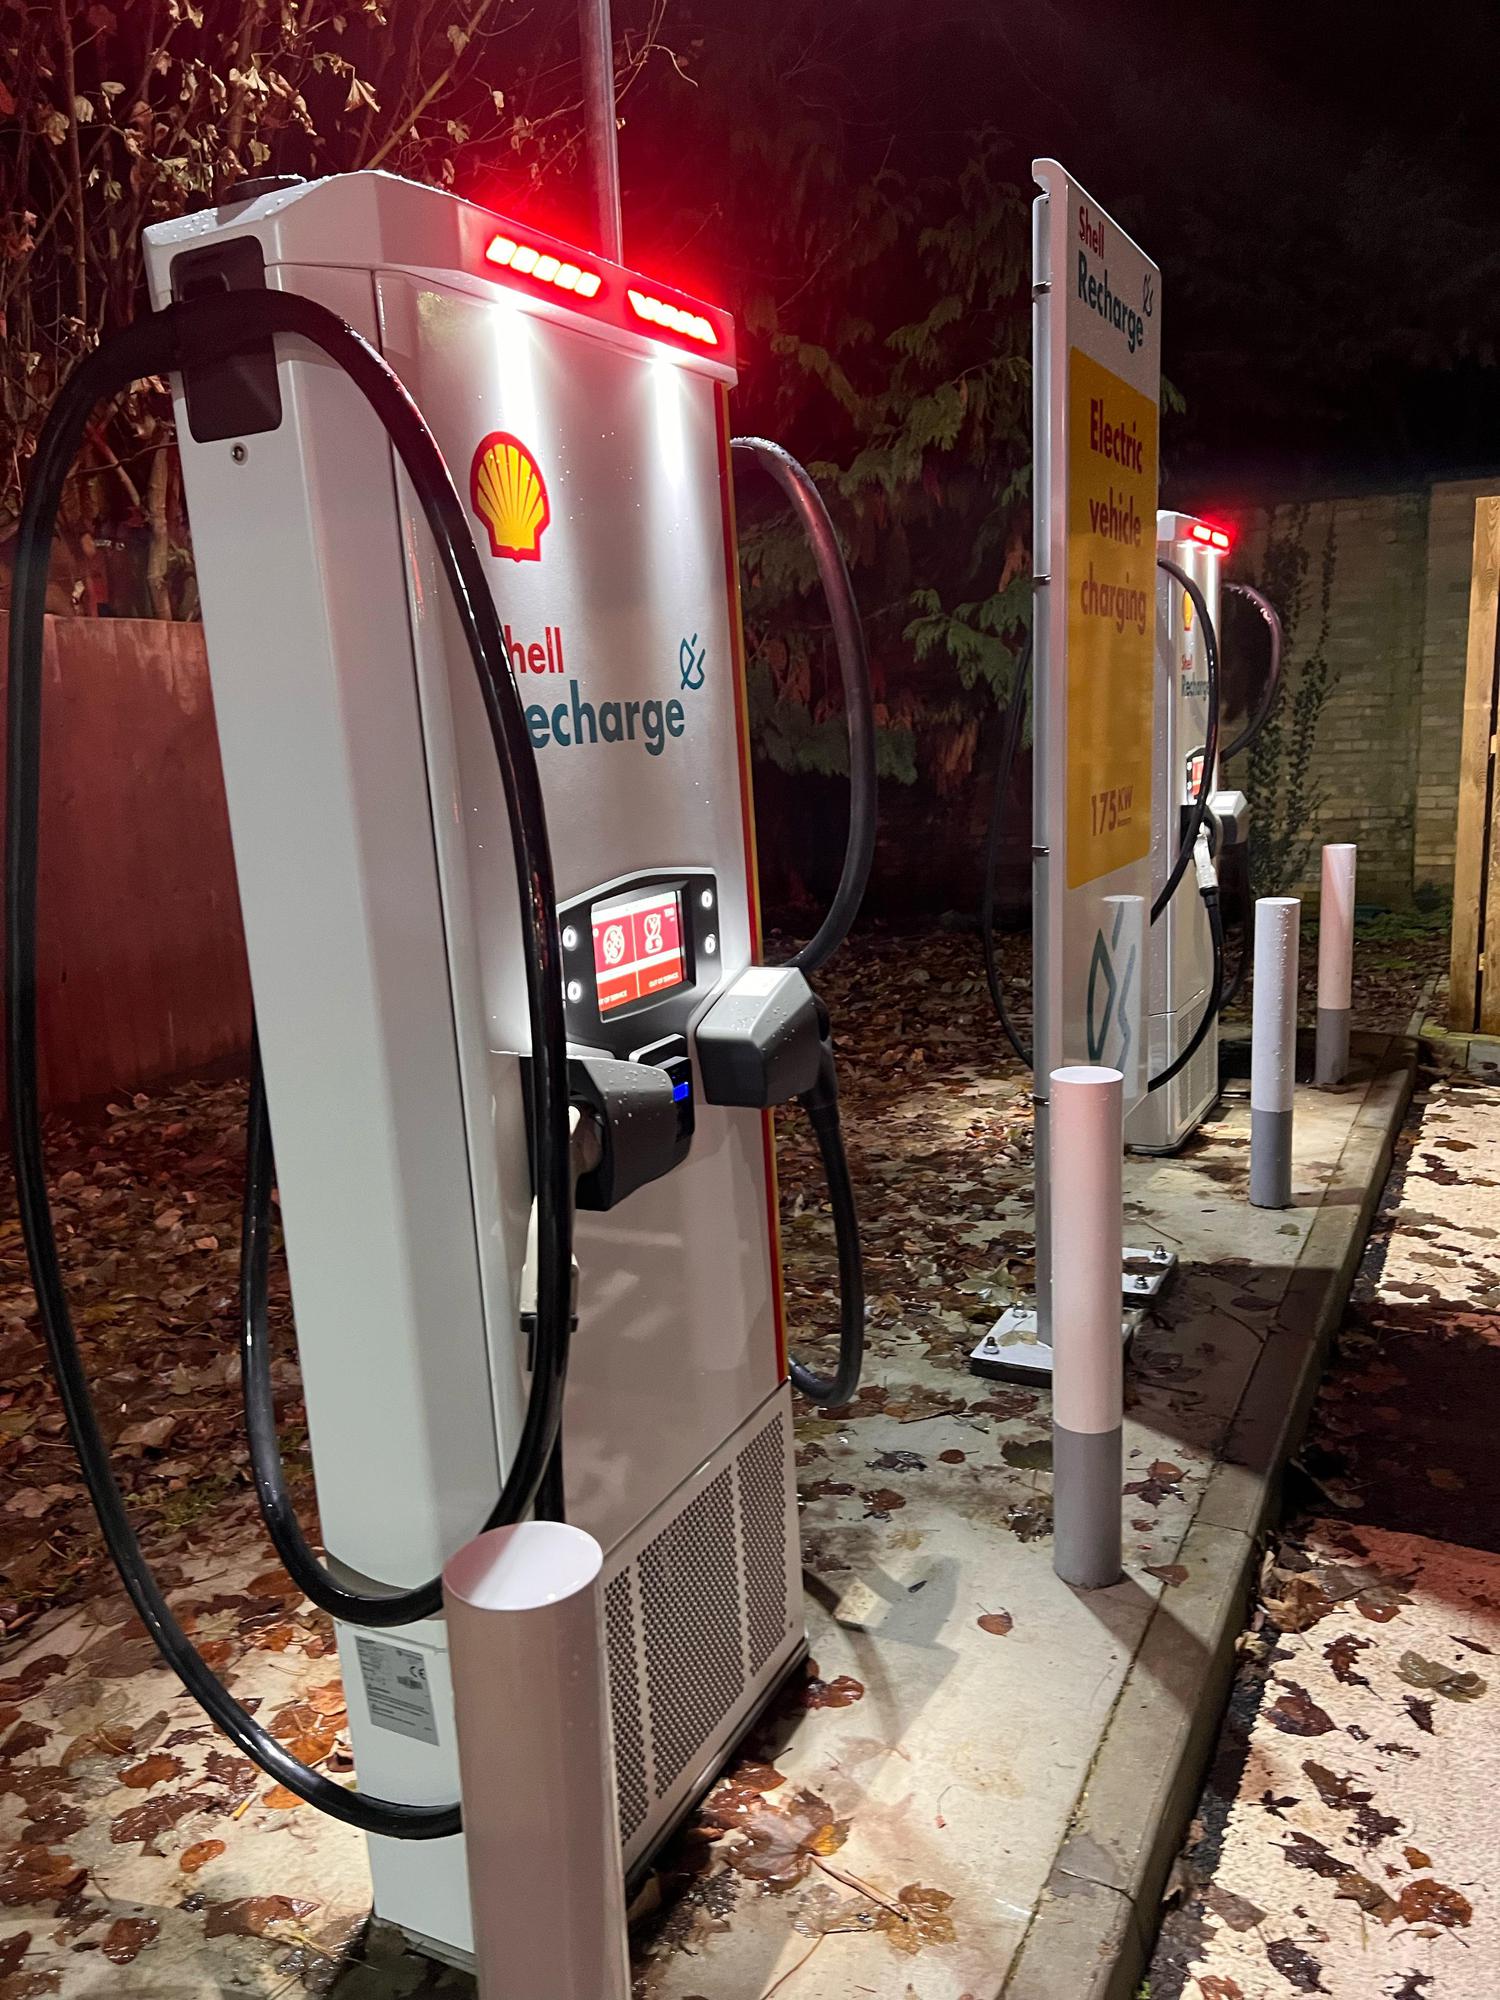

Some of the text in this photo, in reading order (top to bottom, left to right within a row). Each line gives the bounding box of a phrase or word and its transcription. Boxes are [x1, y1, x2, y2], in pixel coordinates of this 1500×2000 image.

[1079, 206, 1104, 260] Shell
[1078, 249, 1144, 354] Recharge
[1090, 398, 1143, 474] Electric
[1089, 487, 1142, 547] vehicle
[1081, 562, 1147, 635] charging
[504, 625, 564, 674] hell
[524, 679, 686, 757] echarge
